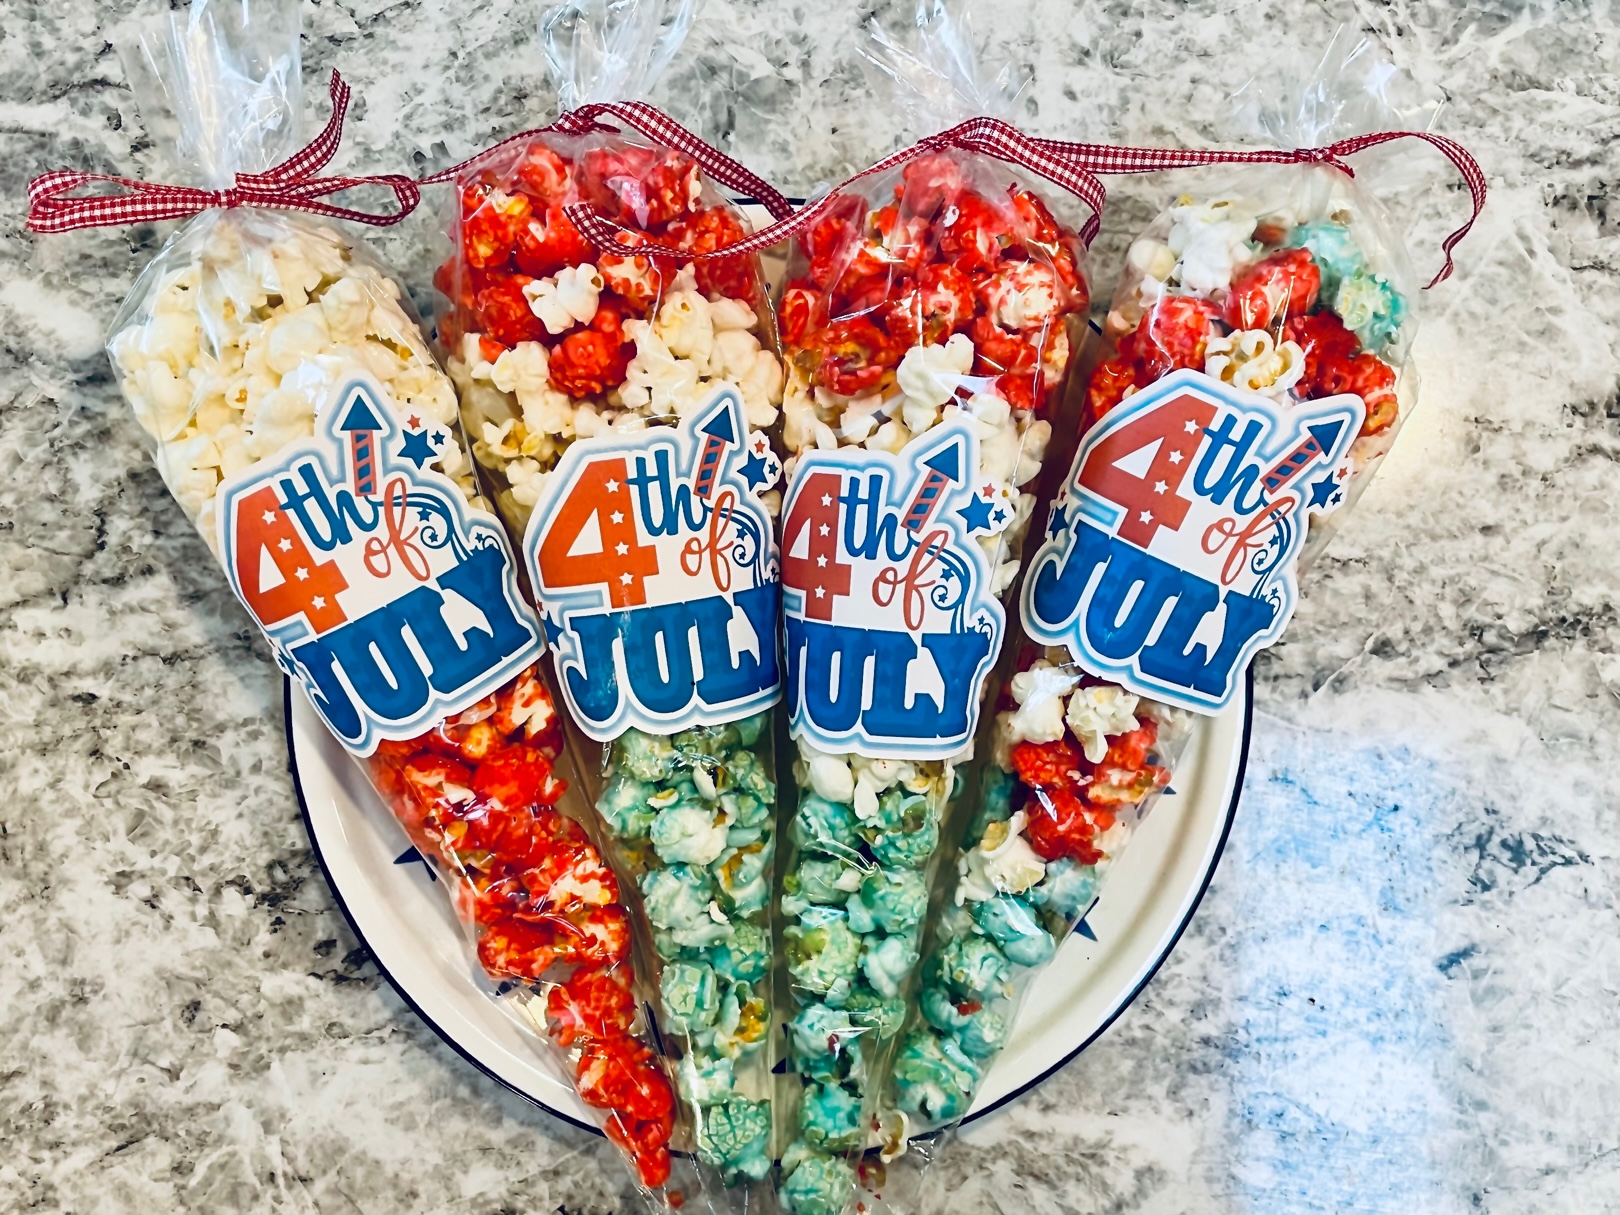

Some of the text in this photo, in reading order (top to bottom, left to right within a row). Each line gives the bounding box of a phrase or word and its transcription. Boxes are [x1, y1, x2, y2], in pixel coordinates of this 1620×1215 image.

[363, 477, 430, 581] of
[538, 450, 708, 608] 4th
[680, 491, 734, 592] of
[1077, 394, 1266, 549] 4th
[1200, 496, 1295, 586] of
[236, 463, 380, 634] 4th
[782, 473, 914, 621] 4th
[872, 530, 949, 631] of
[1033, 520, 1276, 698] JULY
[290, 547, 531, 738] JULY
[566, 582, 780, 722] JULY
